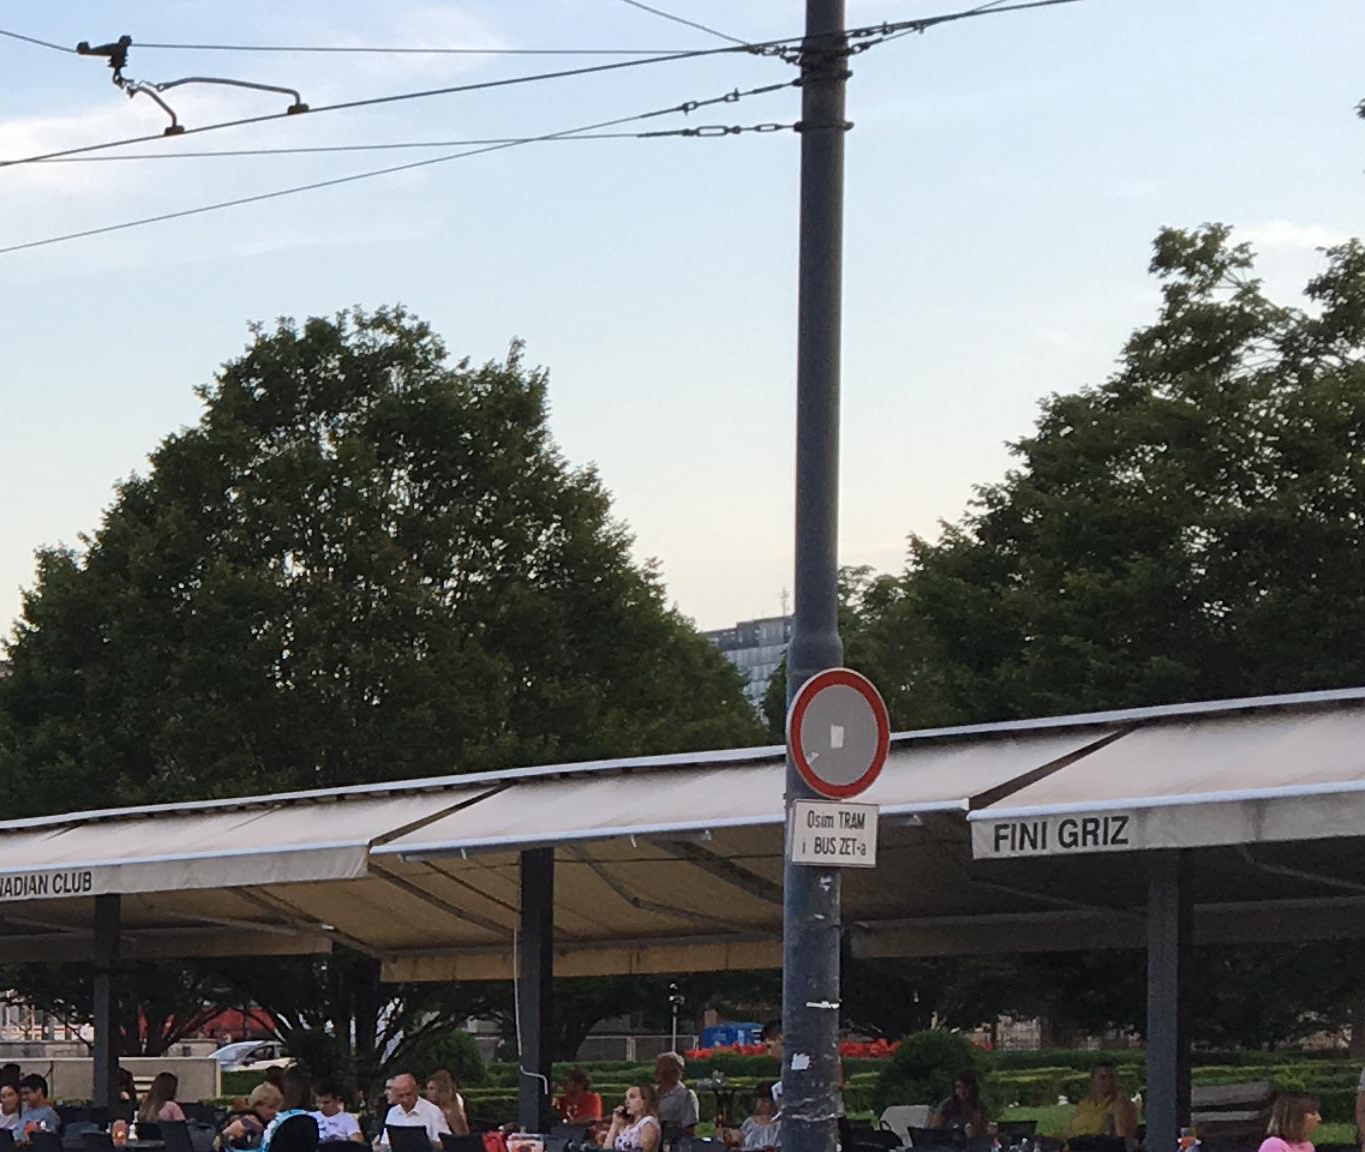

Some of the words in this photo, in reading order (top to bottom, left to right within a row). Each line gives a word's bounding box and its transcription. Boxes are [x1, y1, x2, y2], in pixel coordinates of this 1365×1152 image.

[807, 810, 834, 829] Osim
[838, 811, 866, 830] TRAM
[994, 821, 1047, 852] FINI
[1058, 815, 1129, 848] GRIZ
[814, 837, 837, 855] BUS
[838, 838, 867, 856] ZET-a
[52, 871, 92, 894] CLUB
